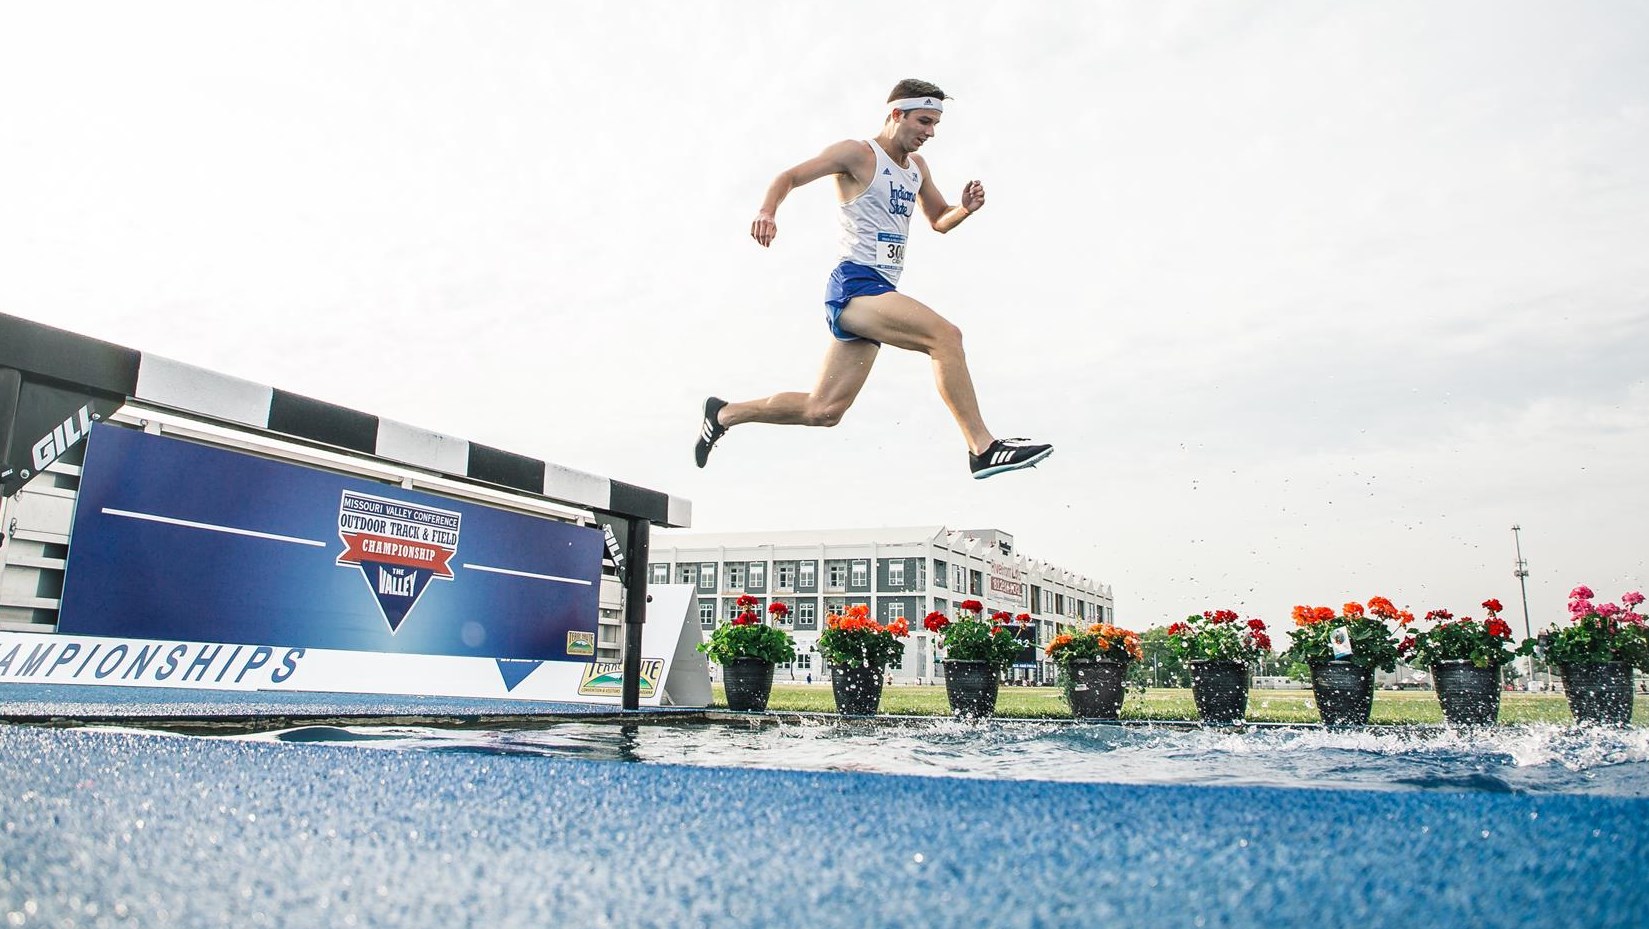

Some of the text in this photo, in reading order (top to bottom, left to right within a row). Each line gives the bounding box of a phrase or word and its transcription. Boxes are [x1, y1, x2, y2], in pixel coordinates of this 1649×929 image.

[888, 198, 913, 218] State
[32, 404, 92, 471] GILL
[344, 497, 458, 527] MISSOURI VALLEY CONFERENCE
[340, 513, 457, 546] OUTDOOR TRACK & FIELD
[362, 539, 436, 562] CHAMPIONSHIP
[379, 565, 418, 597] VALLEY
[392, 567, 405, 576] THE
[0, 642, 306, 684] AMPIONSHIPS
